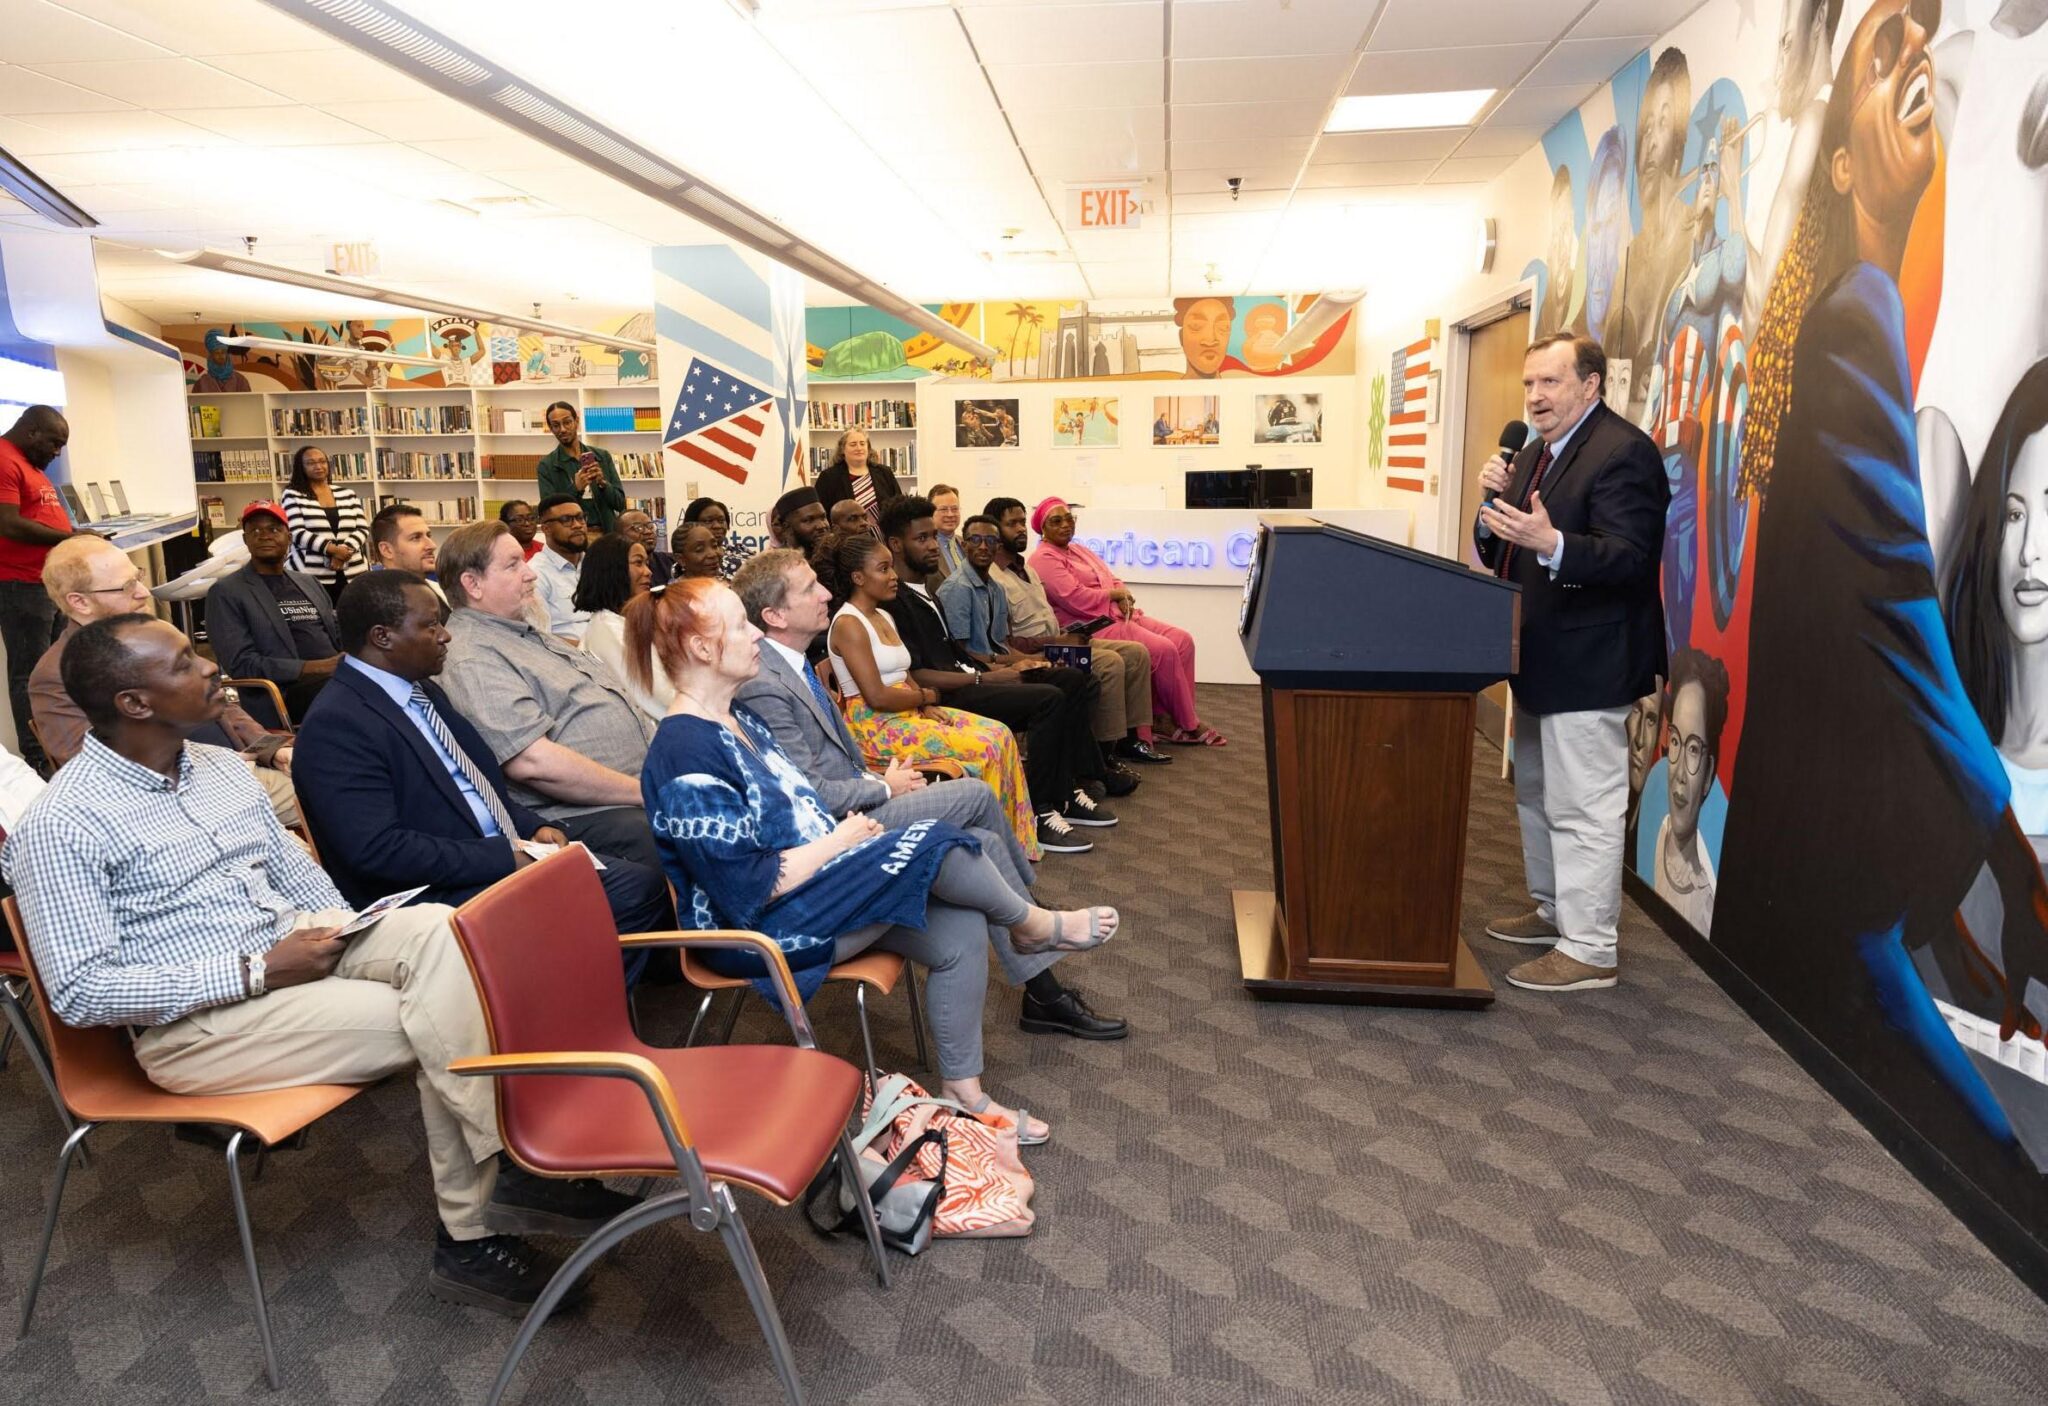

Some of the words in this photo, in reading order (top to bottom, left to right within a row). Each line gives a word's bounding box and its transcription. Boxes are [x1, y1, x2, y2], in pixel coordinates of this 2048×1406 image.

[1081, 189, 1130, 226] EXIT
[333, 242, 371, 275] EXIT
[677, 507, 767, 527] Aican
